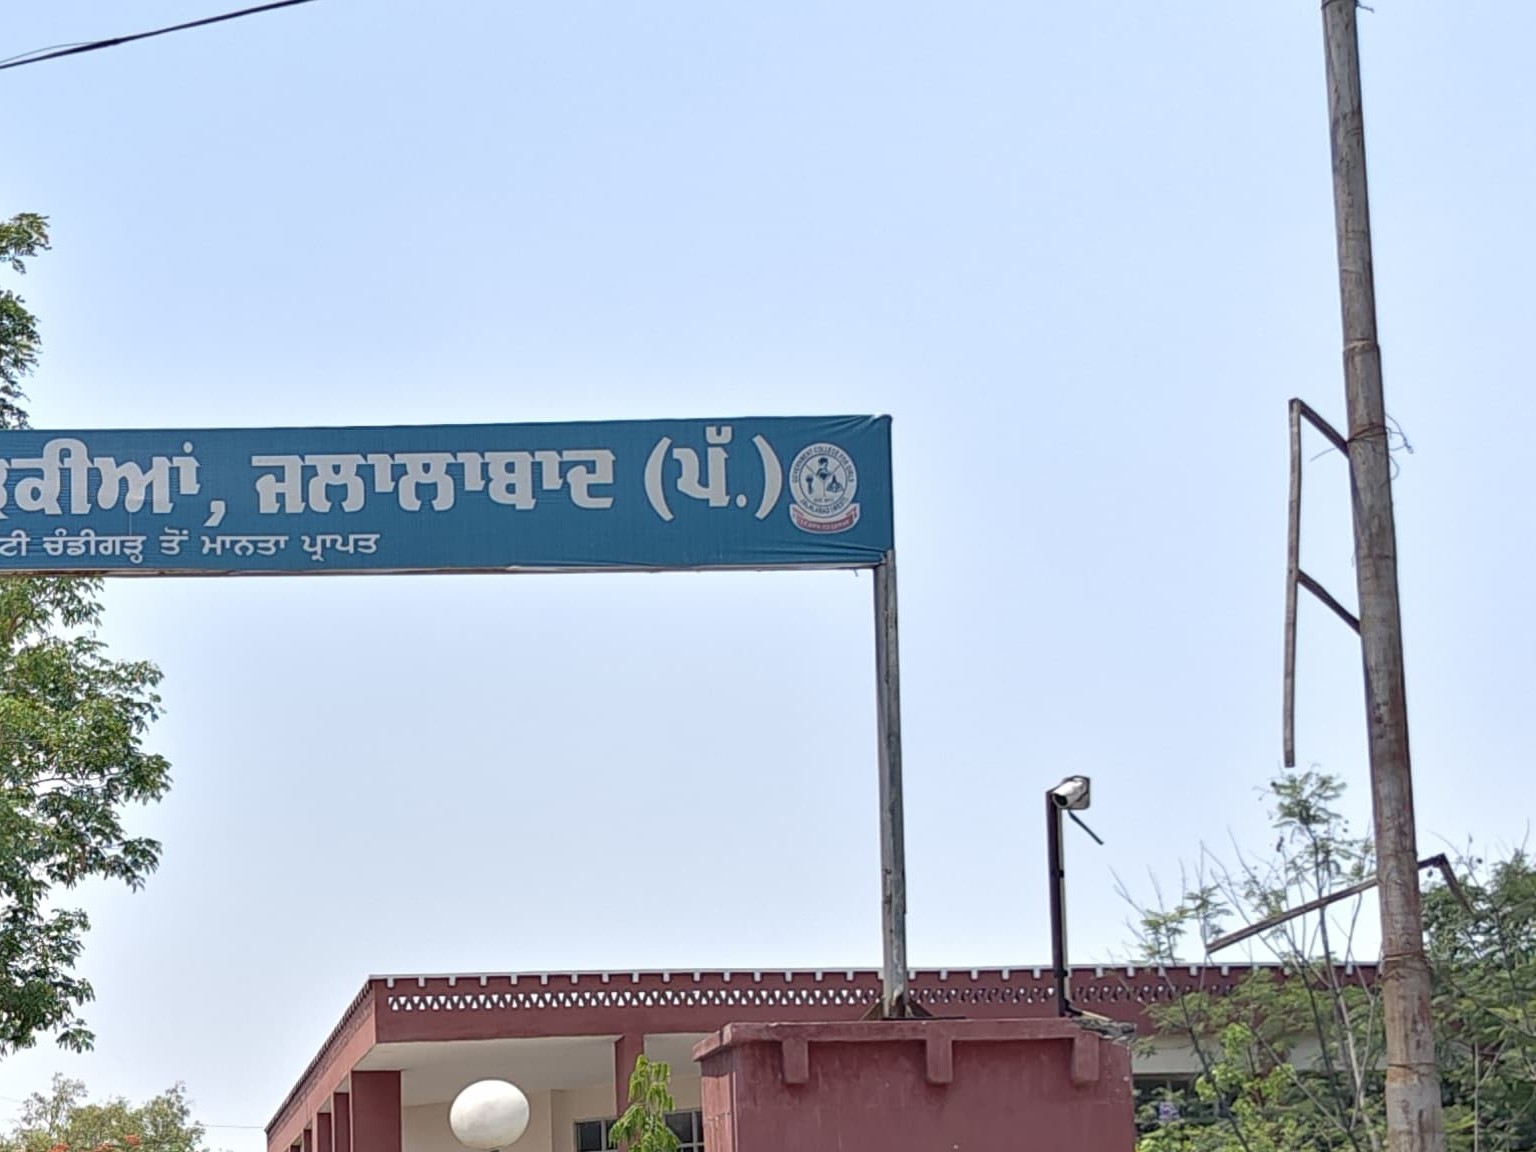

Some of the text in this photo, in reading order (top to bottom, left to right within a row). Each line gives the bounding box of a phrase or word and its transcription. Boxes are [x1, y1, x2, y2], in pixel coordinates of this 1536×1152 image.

[252, 448, 617, 514] ਜਲਾਲਾਬਾਦ
[41, 527, 147, 563] ਚੰਡੀਗੜ੍ਹ
[159, 527, 189, 555] ਤੋਂ
[201, 534, 289, 557] ਮਾਨਤਾ
[301, 533, 381, 562] ਪ੍ਰਾਪਤ
